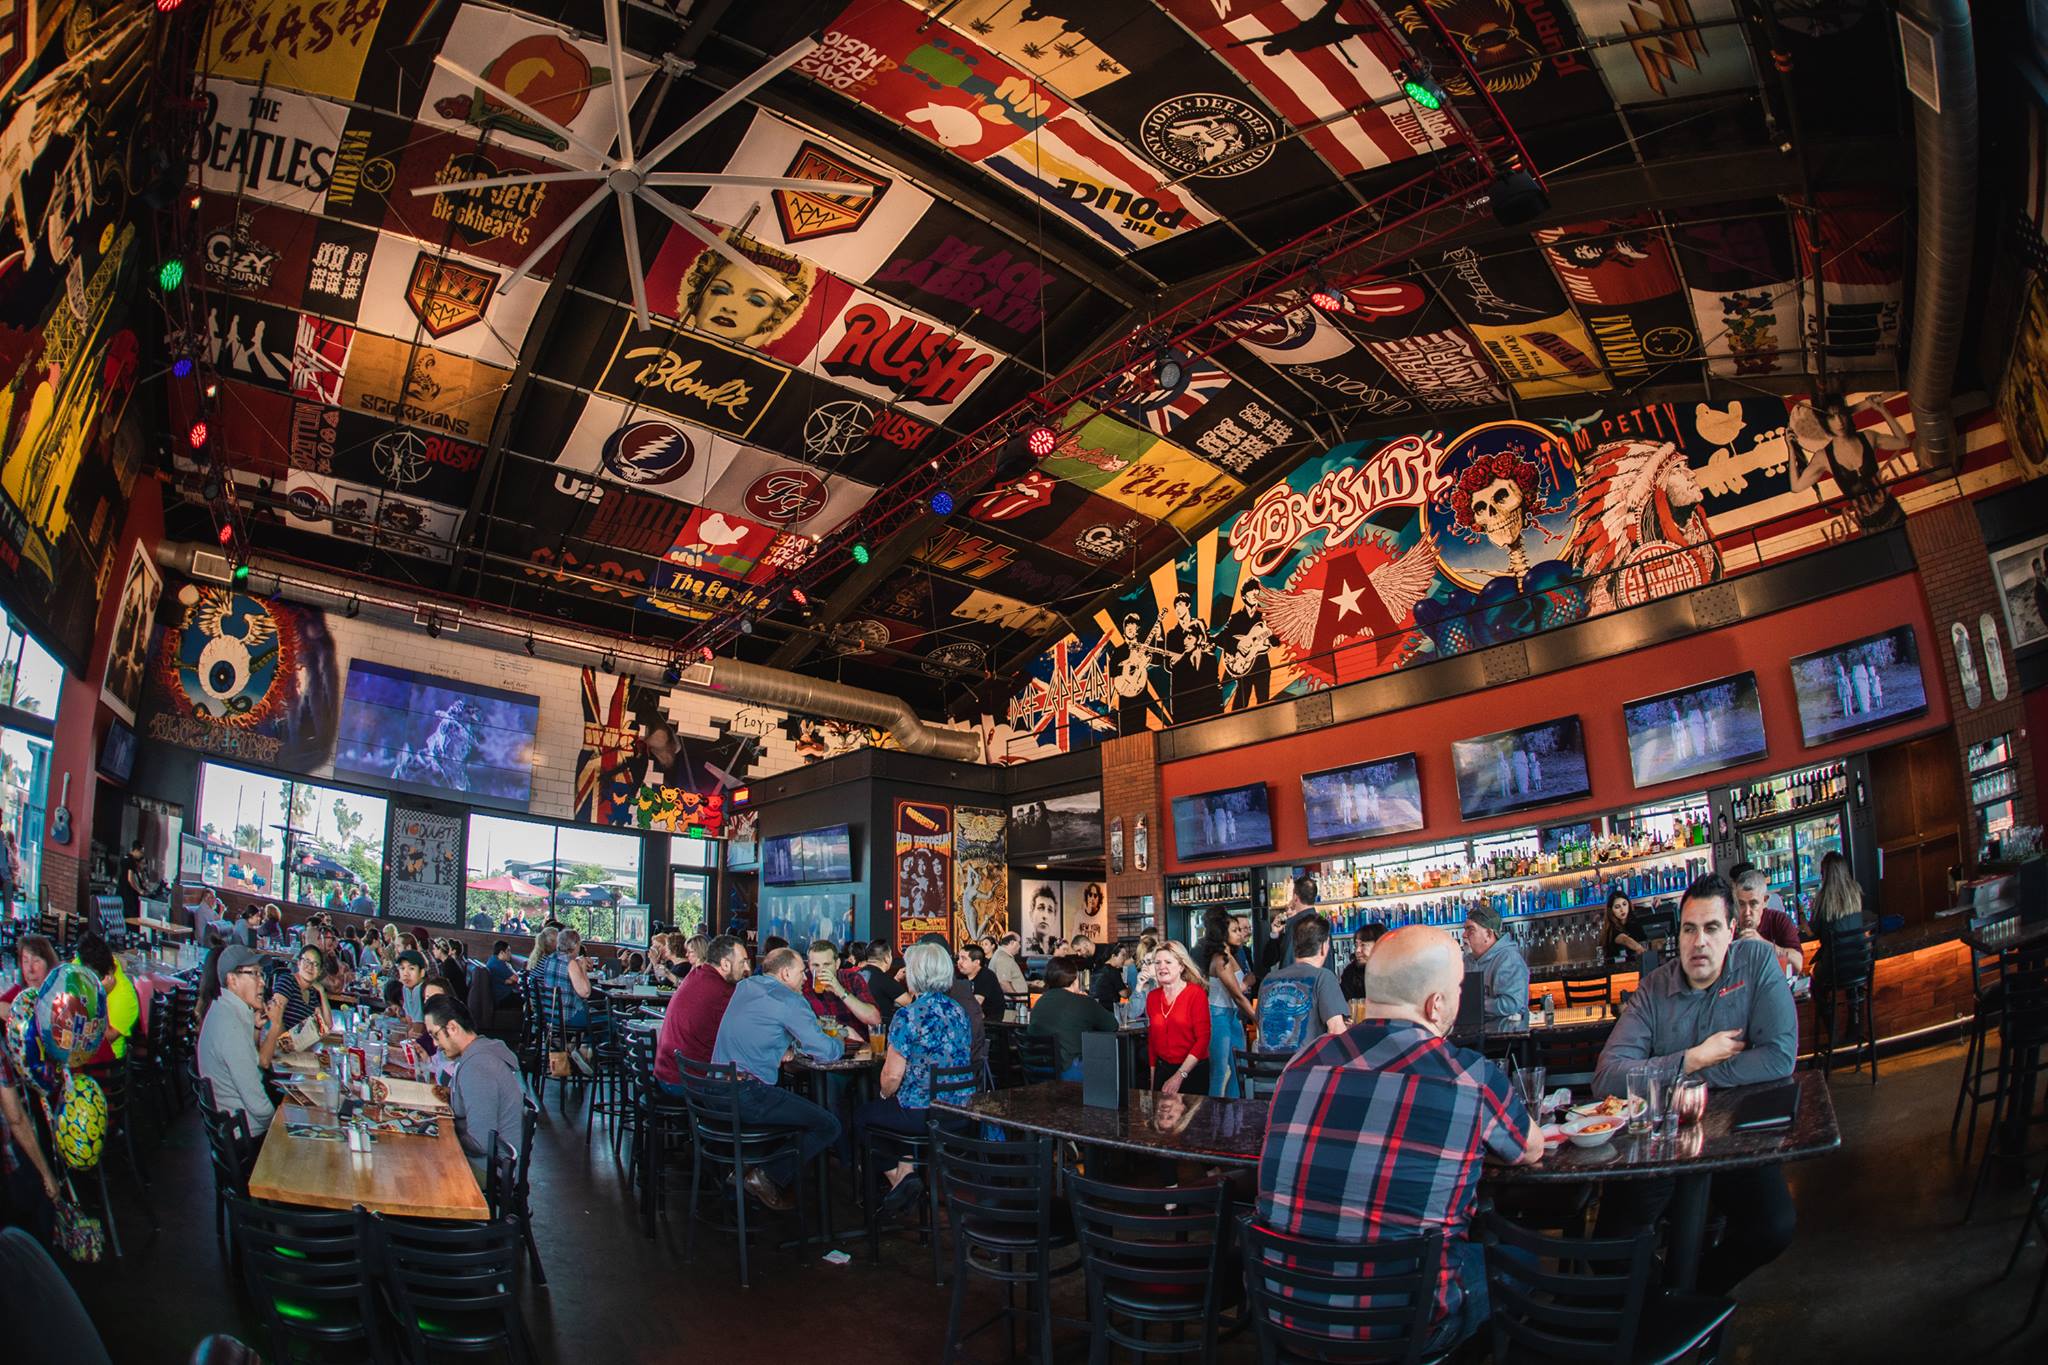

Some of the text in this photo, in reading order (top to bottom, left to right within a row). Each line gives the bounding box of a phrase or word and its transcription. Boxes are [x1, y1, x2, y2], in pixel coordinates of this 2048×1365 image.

[822, 31, 887, 69] MUSIC
[797, 57, 855, 90] DAYS
[247, 97, 283, 123] THE
[1149, 100, 1185, 132] JOEY
[1193, 96, 1269, 136] DEE DEE
[188, 91, 335, 193] BEATLES
[1146, 135, 1199, 172] OHNNY
[325, 130, 372, 207] NIRVANA
[789, 198, 842, 231] ARMY
[1058, 177, 1189, 230] POLICE
[1120, 218, 1157, 237] THE
[416, 262, 487, 304] KISS
[927, 235, 1058, 301] BLACK
[820, 303, 994, 406] RUSH
[624, 346, 753, 422] Blondie
[361, 393, 469, 436] SCORPIONS
[866, 410, 935, 450] RUSH
[425, 436, 482, 472] RUSH
[1539, 402, 1686, 491] TOM PETTY
[554, 472, 604, 504] U2
[1119, 477, 1236, 512] CLASH
[1229, 432, 1454, 576] AEROSMITH
[669, 572, 704, 594] The
[734, 708, 776, 739] FLOYD
[1008, 682, 1039, 730] DEF
[418, 822, 453, 839] DOUBT
